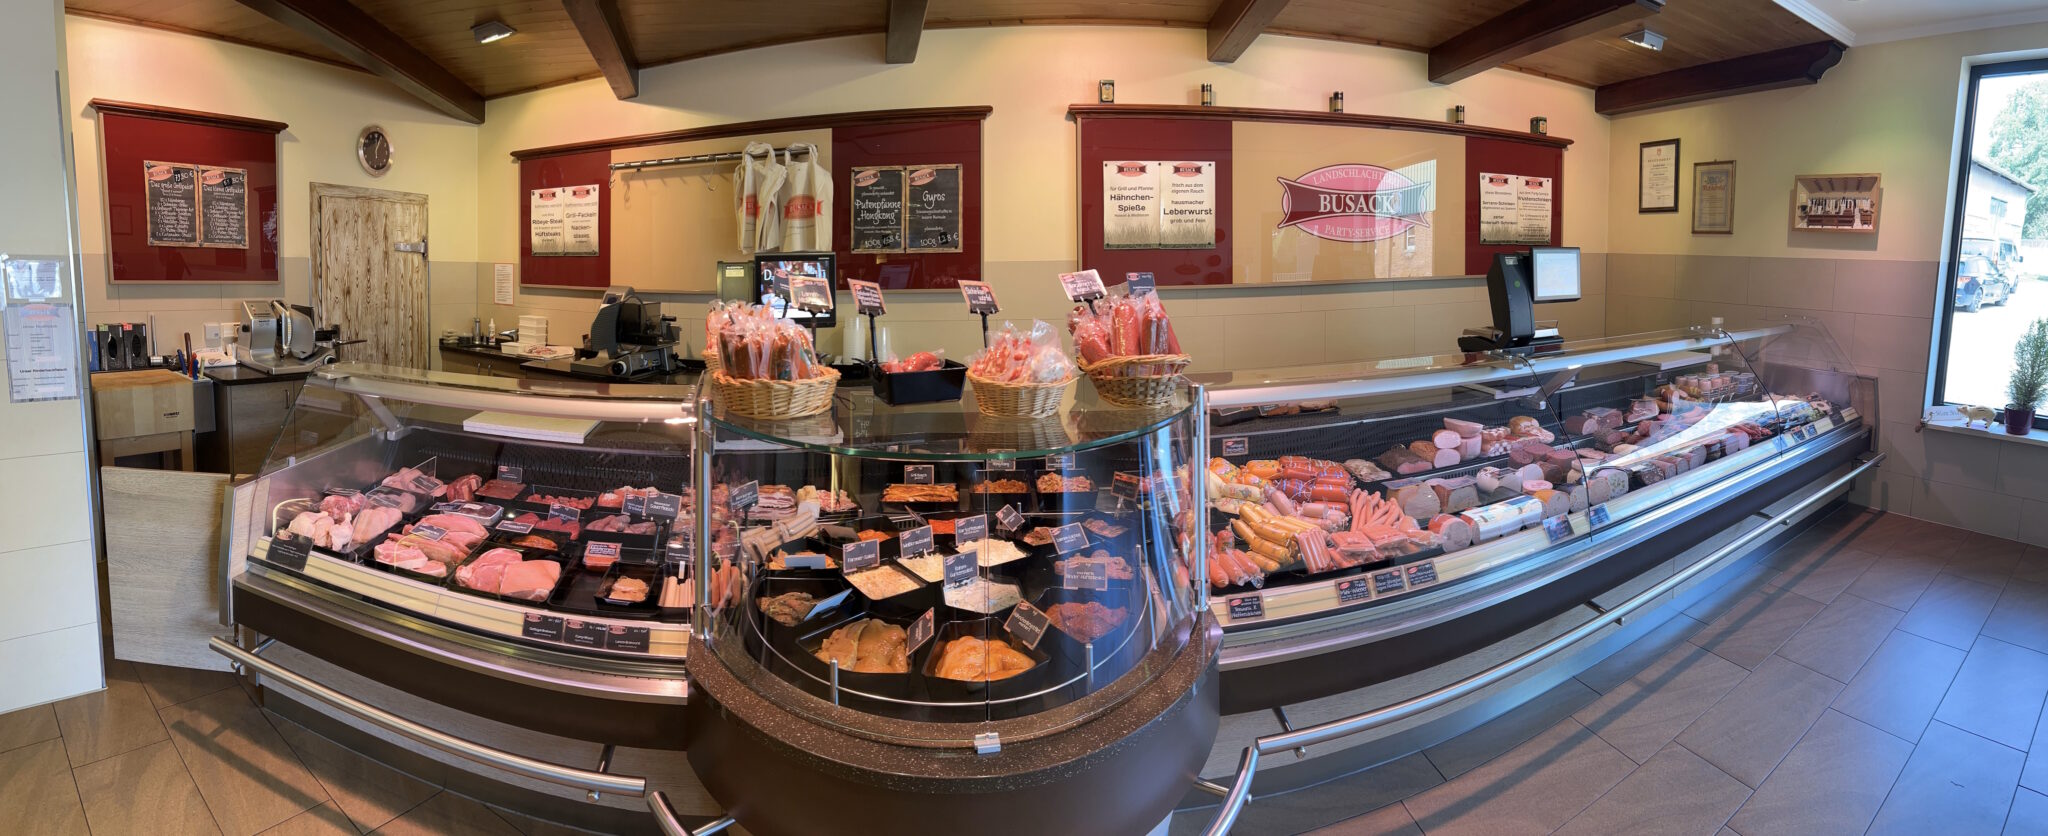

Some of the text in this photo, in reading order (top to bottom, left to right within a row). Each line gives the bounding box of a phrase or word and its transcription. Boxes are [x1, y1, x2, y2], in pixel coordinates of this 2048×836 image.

[855, 199, 902, 212] Putenpfanne
[922, 190, 946, 209] Gyros
[1318, 193, 1397, 213] BUSACK
[1118, 204, 1146, 213] Spieße
[1163, 208, 1213, 216] Leberwurst
